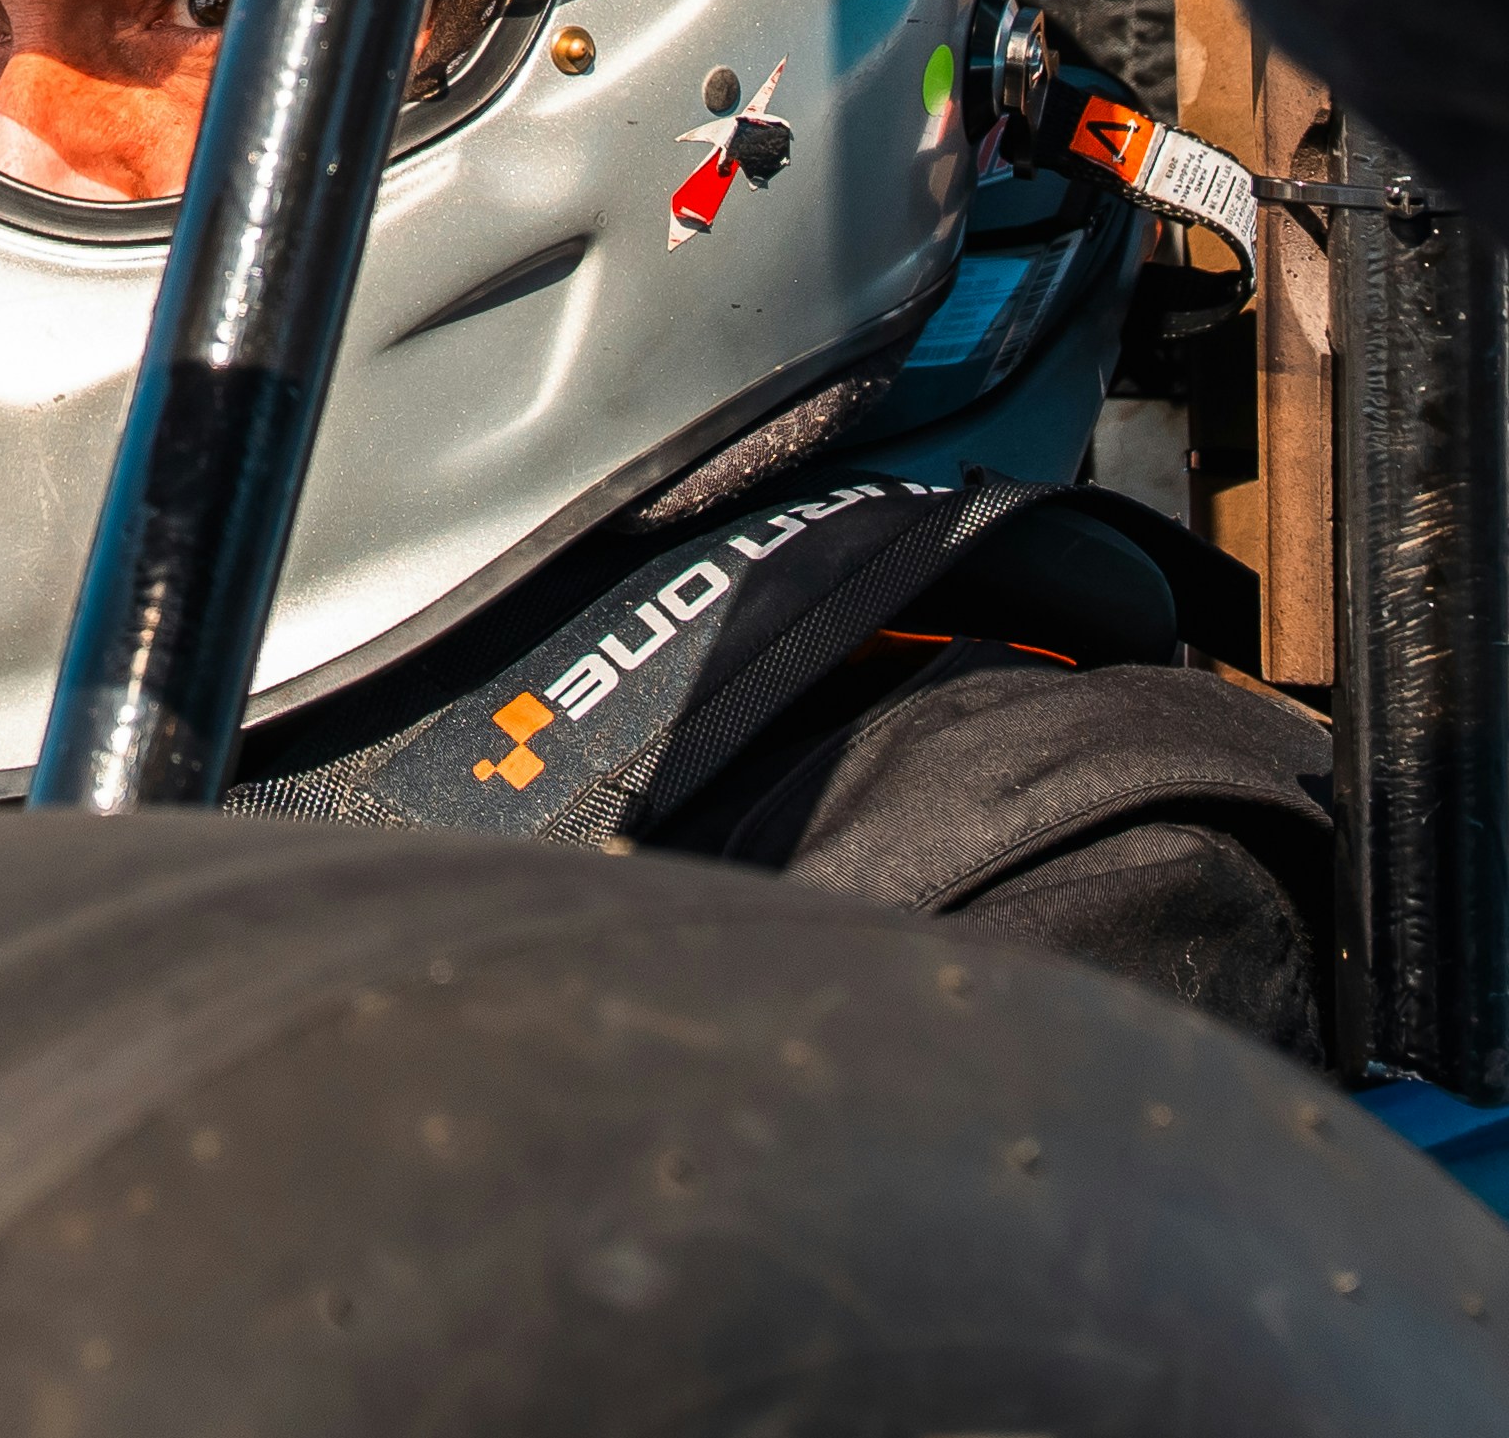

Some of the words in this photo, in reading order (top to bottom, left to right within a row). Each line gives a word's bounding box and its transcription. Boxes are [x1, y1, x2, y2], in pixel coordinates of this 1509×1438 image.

[1172, 152, 1196, 195] Products
[1179, 149, 1209, 204] Performance
[1193, 168, 1208, 194] HANS
[1234, 187, 1252, 229] tandard
[728, 481, 954, 560] RN
[543, 561, 731, 723] ONE
